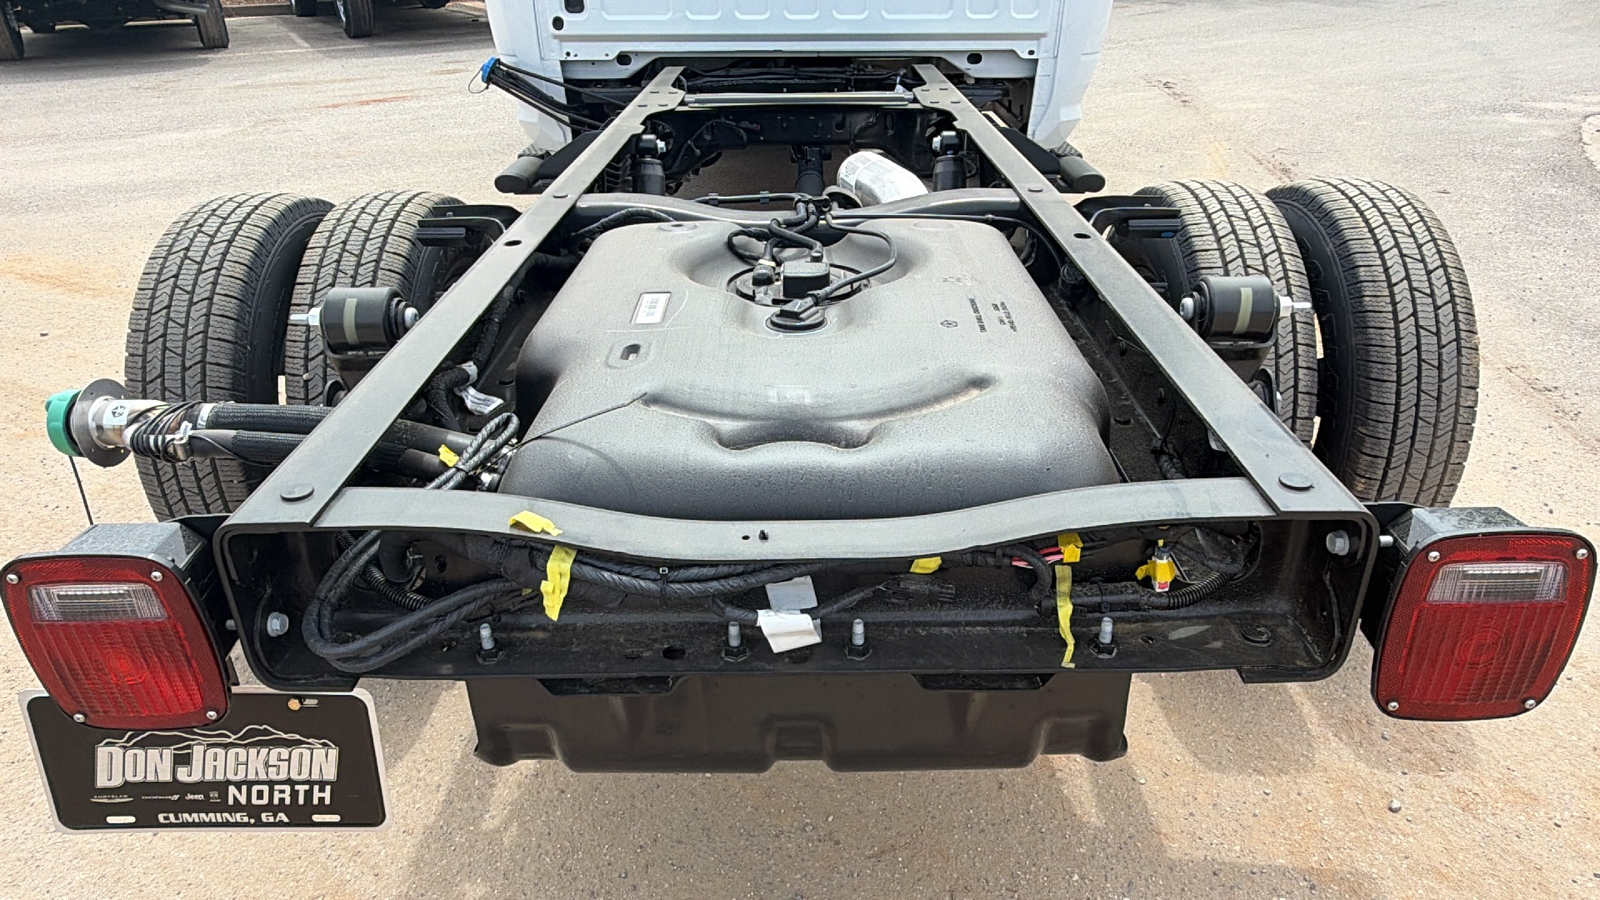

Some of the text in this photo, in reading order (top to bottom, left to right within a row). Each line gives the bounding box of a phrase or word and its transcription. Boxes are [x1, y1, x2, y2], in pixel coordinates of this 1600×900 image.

[94, 744, 340, 787] DON JACKSON
[184, 792, 204, 801] Jeep
[228, 784, 332, 806] NORTH
[157, 812, 291, 825] CUMMING, GA
